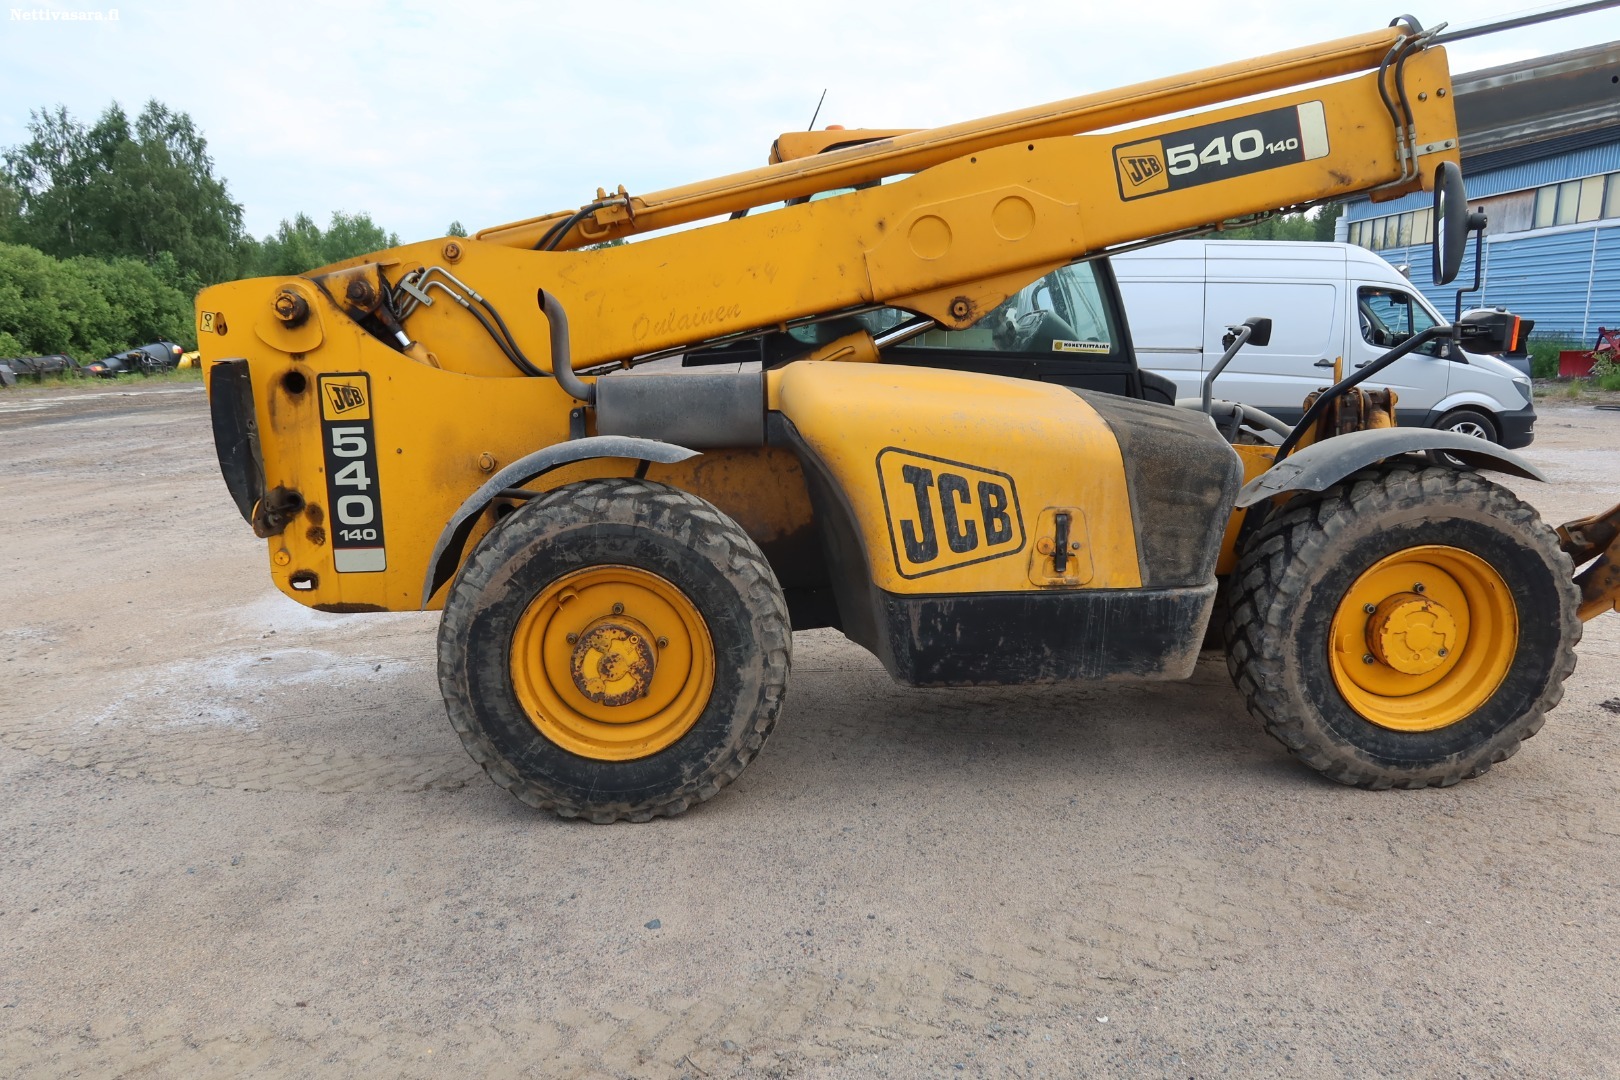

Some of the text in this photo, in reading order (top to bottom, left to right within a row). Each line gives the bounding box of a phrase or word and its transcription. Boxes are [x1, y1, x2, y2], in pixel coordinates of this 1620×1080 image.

[1127, 129, 1299, 183] JCB 540 140
[632, 303, 742, 342] Oulainen
[332, 386, 362, 411] JCB
[331, 426, 374, 526] 540
[339, 528, 377, 541] 140
[899, 464, 1013, 564] JCB
